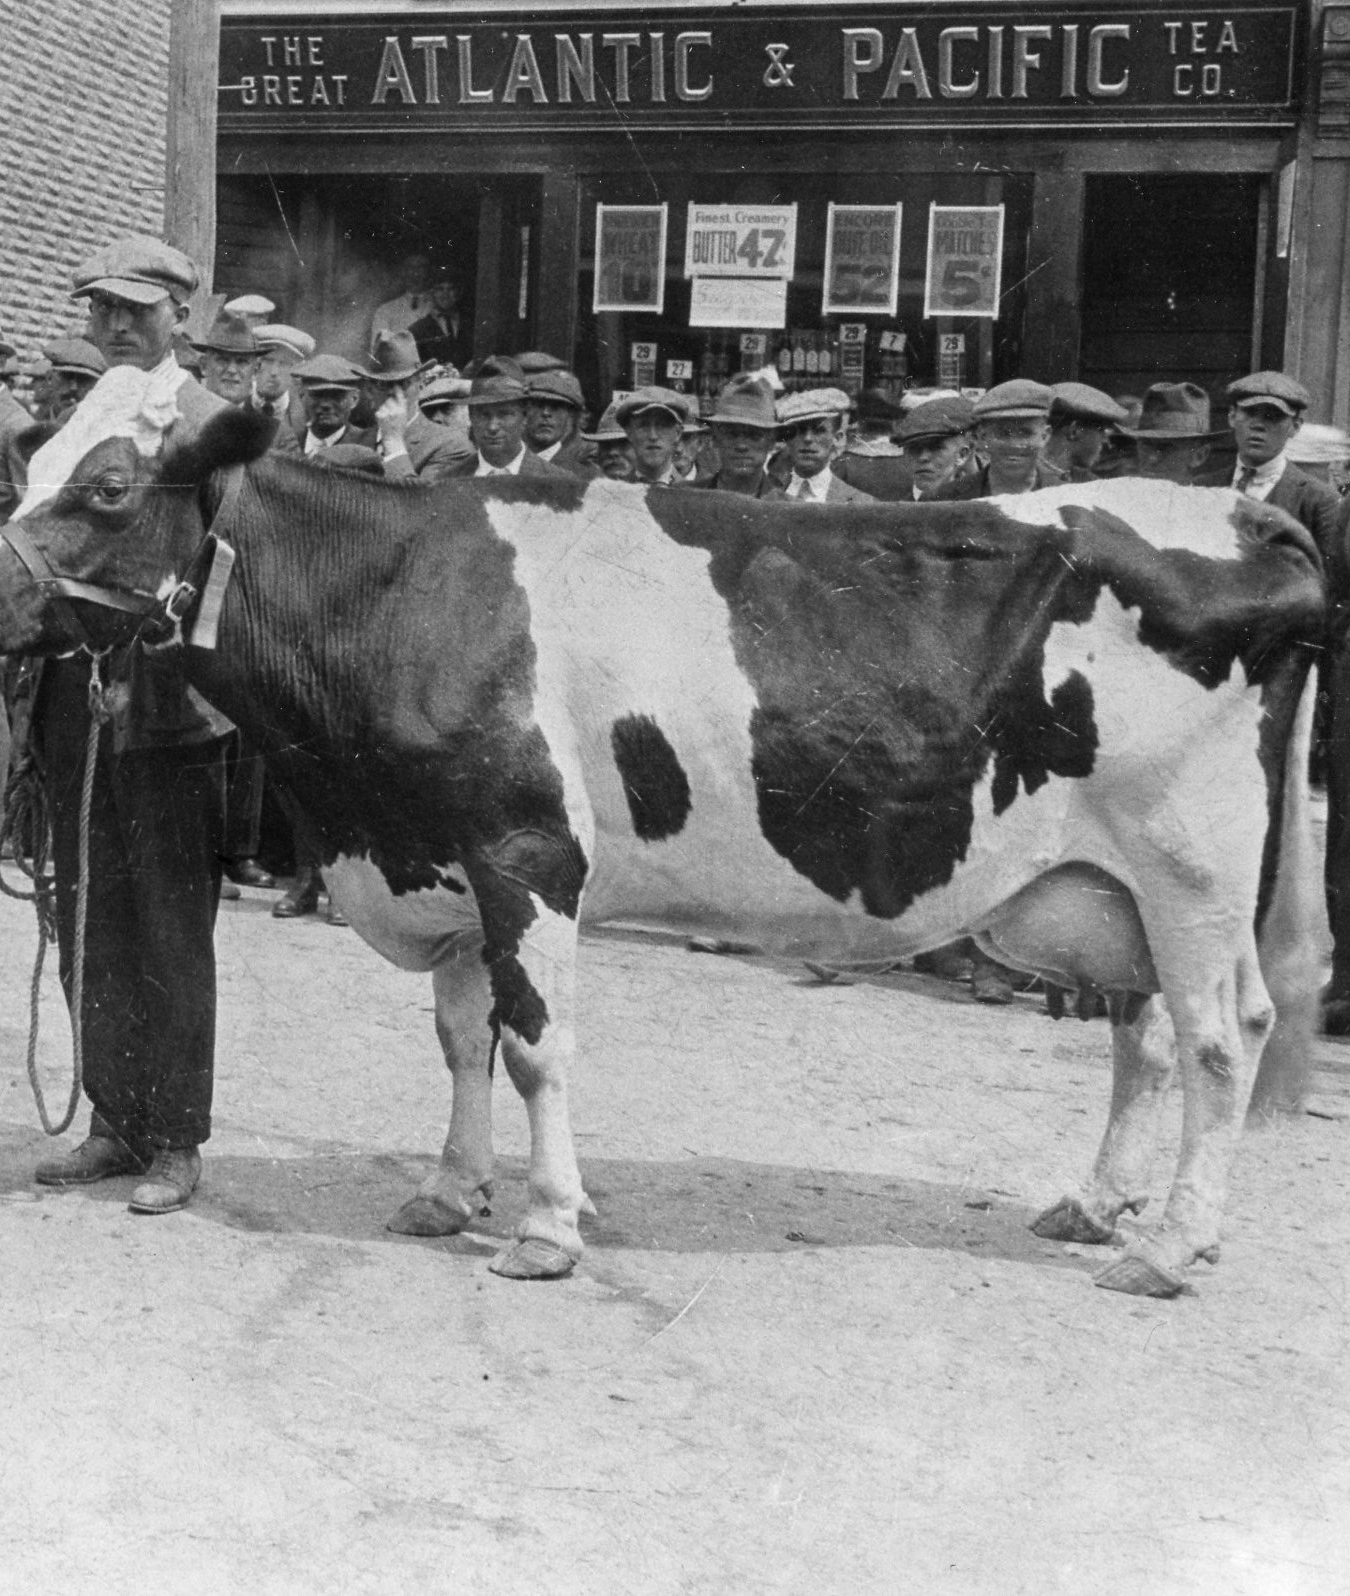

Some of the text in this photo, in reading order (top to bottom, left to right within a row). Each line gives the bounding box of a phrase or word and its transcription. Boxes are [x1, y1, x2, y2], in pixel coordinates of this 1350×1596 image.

[261, 36, 325, 66] THE
[1163, 21, 1239, 55] TEA
[371, 24, 1130, 104] ATLANTIC & PACIFIC
[241, 75, 348, 105] GREAT
[695, 210, 789, 227] Finest Creamery
[692, 230, 738, 264] BUTTER
[636, 345, 650, 359] 29
[671, 363, 686, 376] 27
